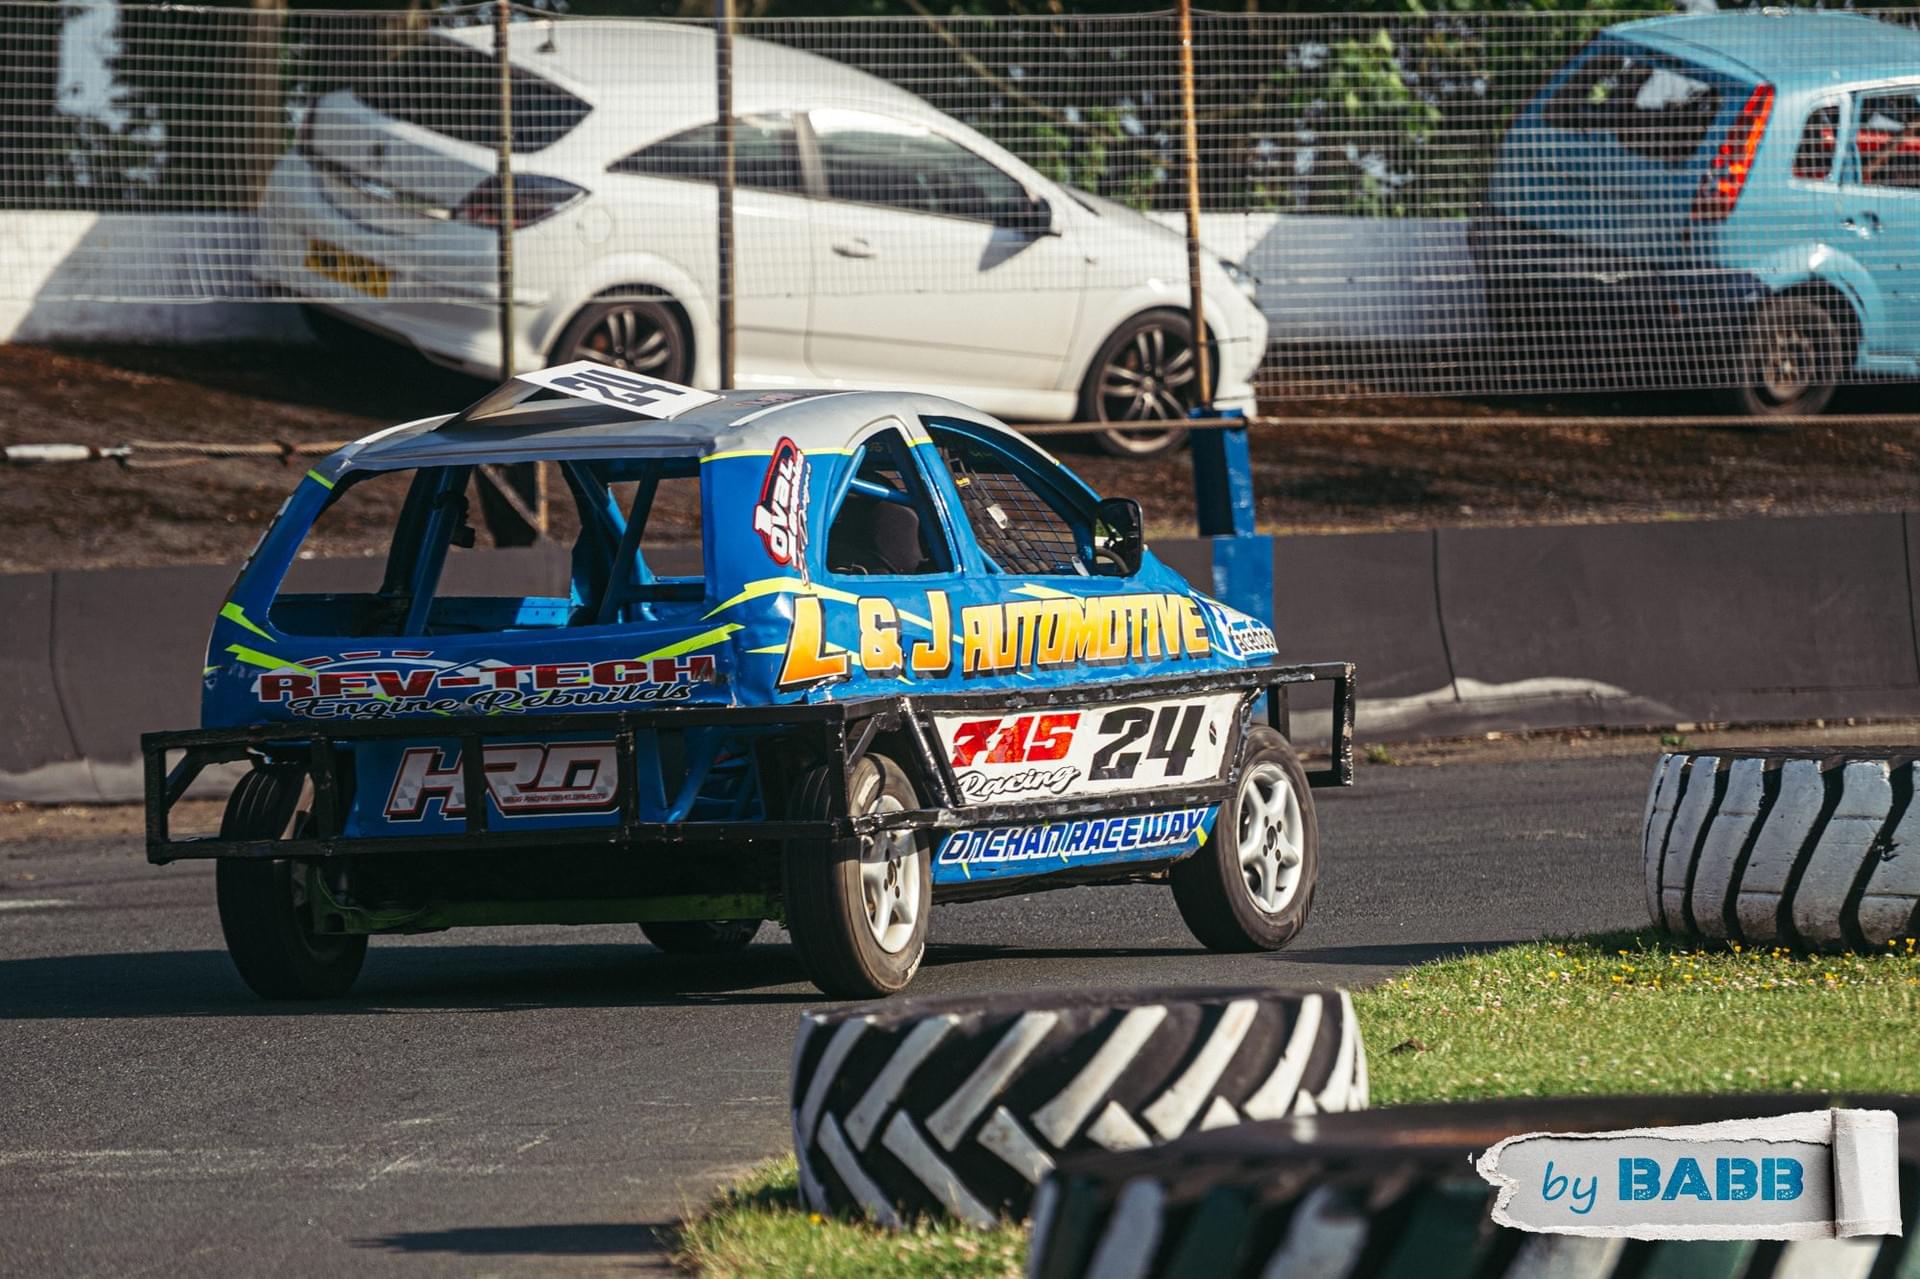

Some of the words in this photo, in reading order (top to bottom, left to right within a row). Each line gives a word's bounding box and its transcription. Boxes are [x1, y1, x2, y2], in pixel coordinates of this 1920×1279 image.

[550, 369, 686, 407] 24
[777, 595, 849, 692] L
[858, 597, 904, 678] &
[911, 588, 952, 677] J
[961, 593, 1211, 678] AUTOMOTIVE
[259, 656, 716, 702] REV-TECH
[286, 694, 459, 719] Engine
[467, 682, 691, 713] Rebuilds
[1088, 704, 1206, 781] 24
[957, 764, 1082, 800] Racing
[938, 825, 1067, 864] ONCHAN
[1063, 808, 1208, 857] RACEWAY
